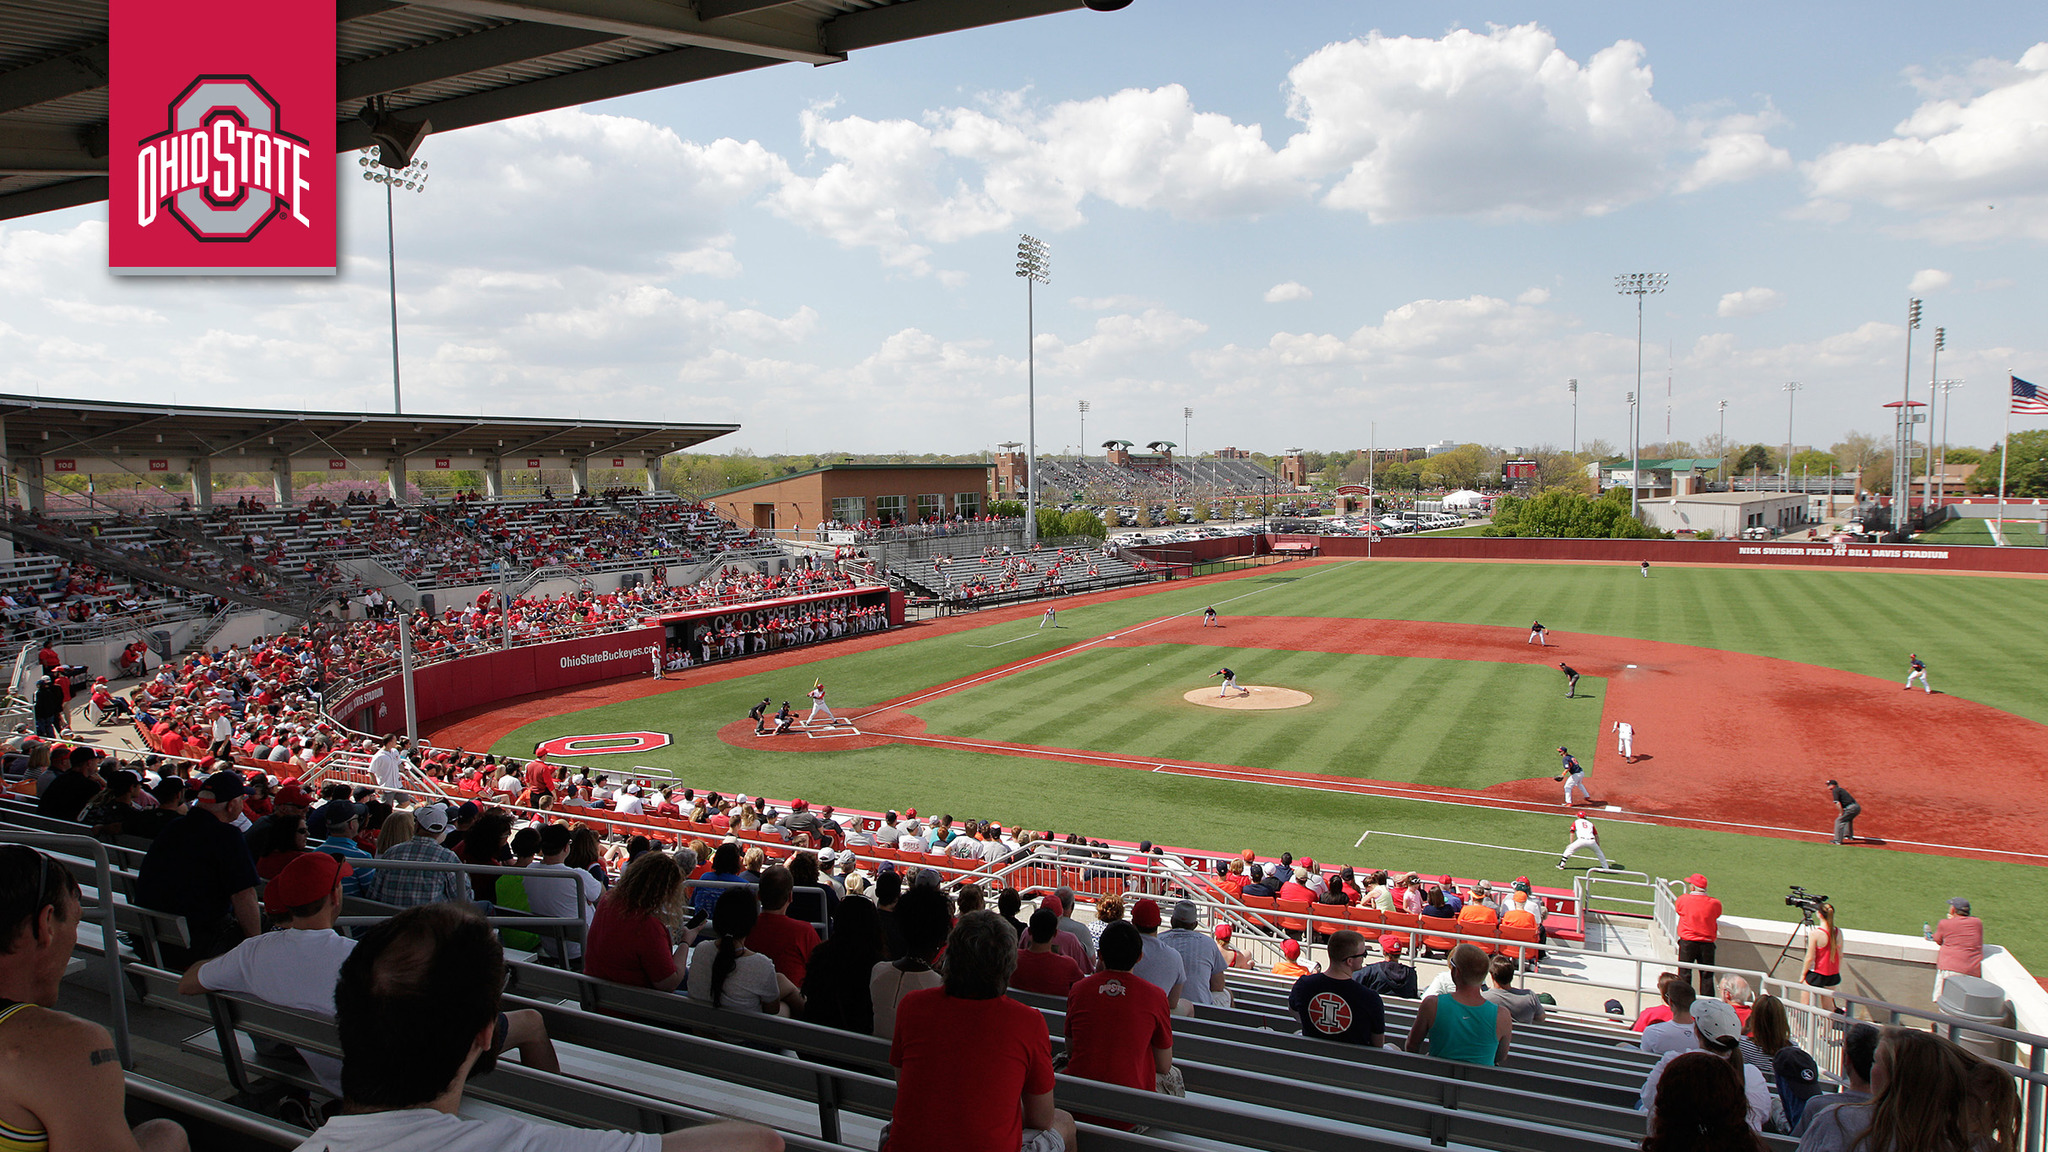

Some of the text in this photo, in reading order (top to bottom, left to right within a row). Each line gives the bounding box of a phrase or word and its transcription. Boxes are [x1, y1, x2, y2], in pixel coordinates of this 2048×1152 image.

[1739, 547, 1761, 555] NICK
[1762, 547, 1805, 555] SWISHER
[1806, 548, 1833, 556] FIELD
[1848, 549, 1870, 557] BILL
[1872, 550, 1901, 558] DAVIS
[1902, 550, 1949, 559] STADIUM
[560, 645, 661, 668] OhioStateBuckeyes.co
[867, 820, 876, 830] 3
[1190, 859, 1200, 870] 2
[1555, 901, 1564, 912] 1
